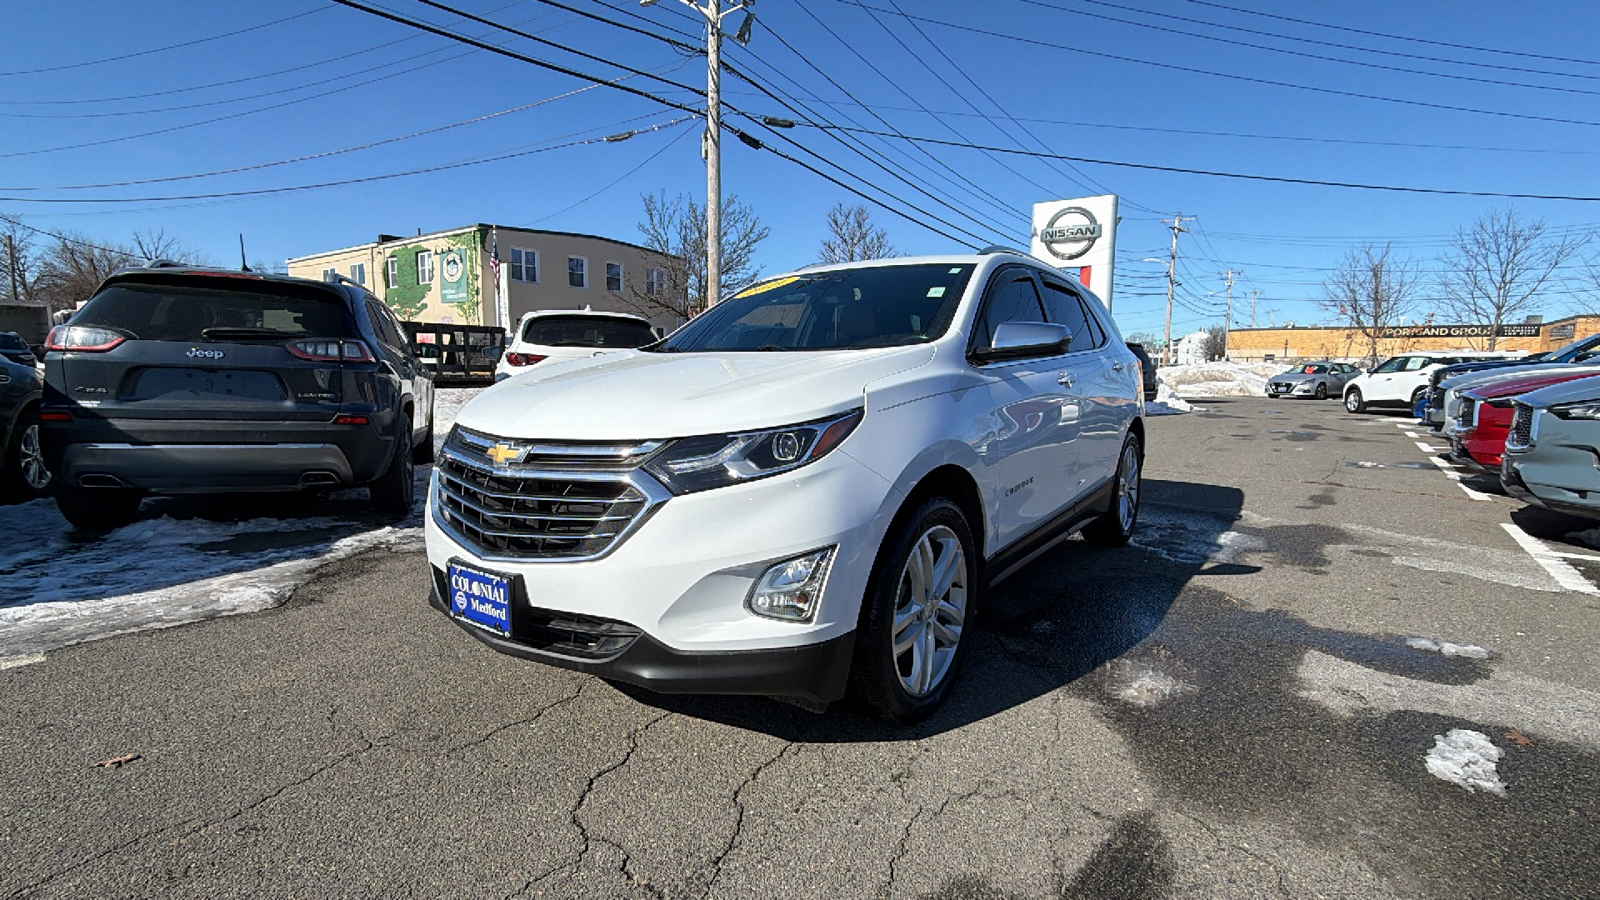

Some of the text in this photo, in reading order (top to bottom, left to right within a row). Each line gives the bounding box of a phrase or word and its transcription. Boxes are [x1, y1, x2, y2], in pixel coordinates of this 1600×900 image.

[1045, 227, 1096, 240] NISSAN
[186, 347, 225, 360] Jeep
[452, 575, 507, 604] COLONIAL
[472, 598, 506, 620] Medford
